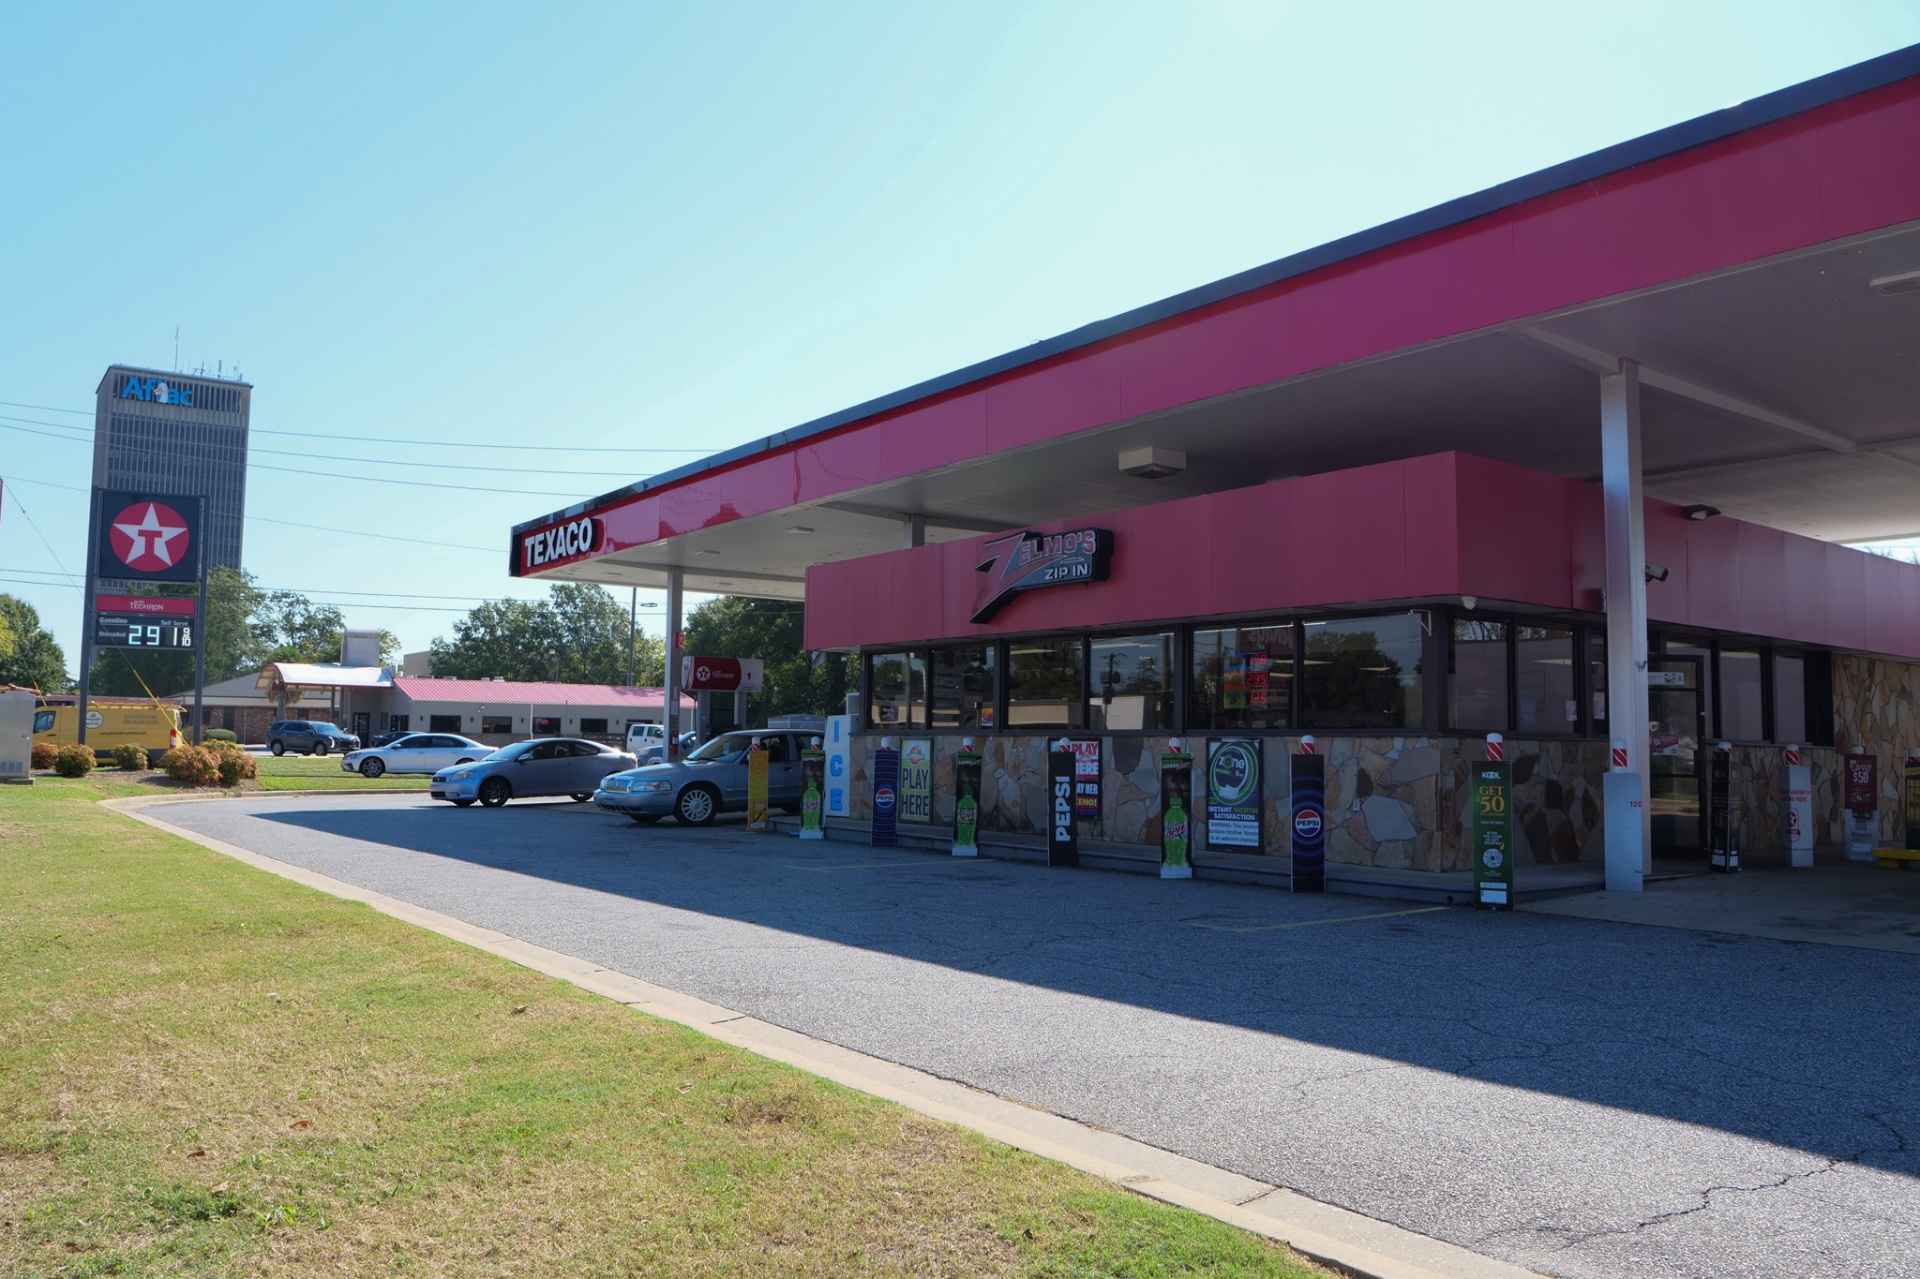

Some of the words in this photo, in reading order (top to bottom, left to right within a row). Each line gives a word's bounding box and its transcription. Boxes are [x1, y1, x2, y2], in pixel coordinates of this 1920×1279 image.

[524, 517, 593, 568] TEXACO
[1045, 567, 1069, 581] ZIP
[1072, 563, 1088, 577] IN
[129, 602, 164, 611] TECHRON
[746, 672, 752, 680] 1
[1246, 673, 1267, 685] 295
[1249, 692, 1267, 705] 125
[1072, 743, 1099, 757] PLAY
[902, 768, 929, 790] PLAY
[1481, 771, 1501, 779] KOOL
[1853, 771, 1869, 784] $50
[1479, 785, 1505, 796] GET
[901, 793, 929, 816] HERE
[1055, 775, 1071, 842] PEPSI
[1475, 795, 1505, 813] $50
[1213, 812, 1256, 821] SATISFACTION
